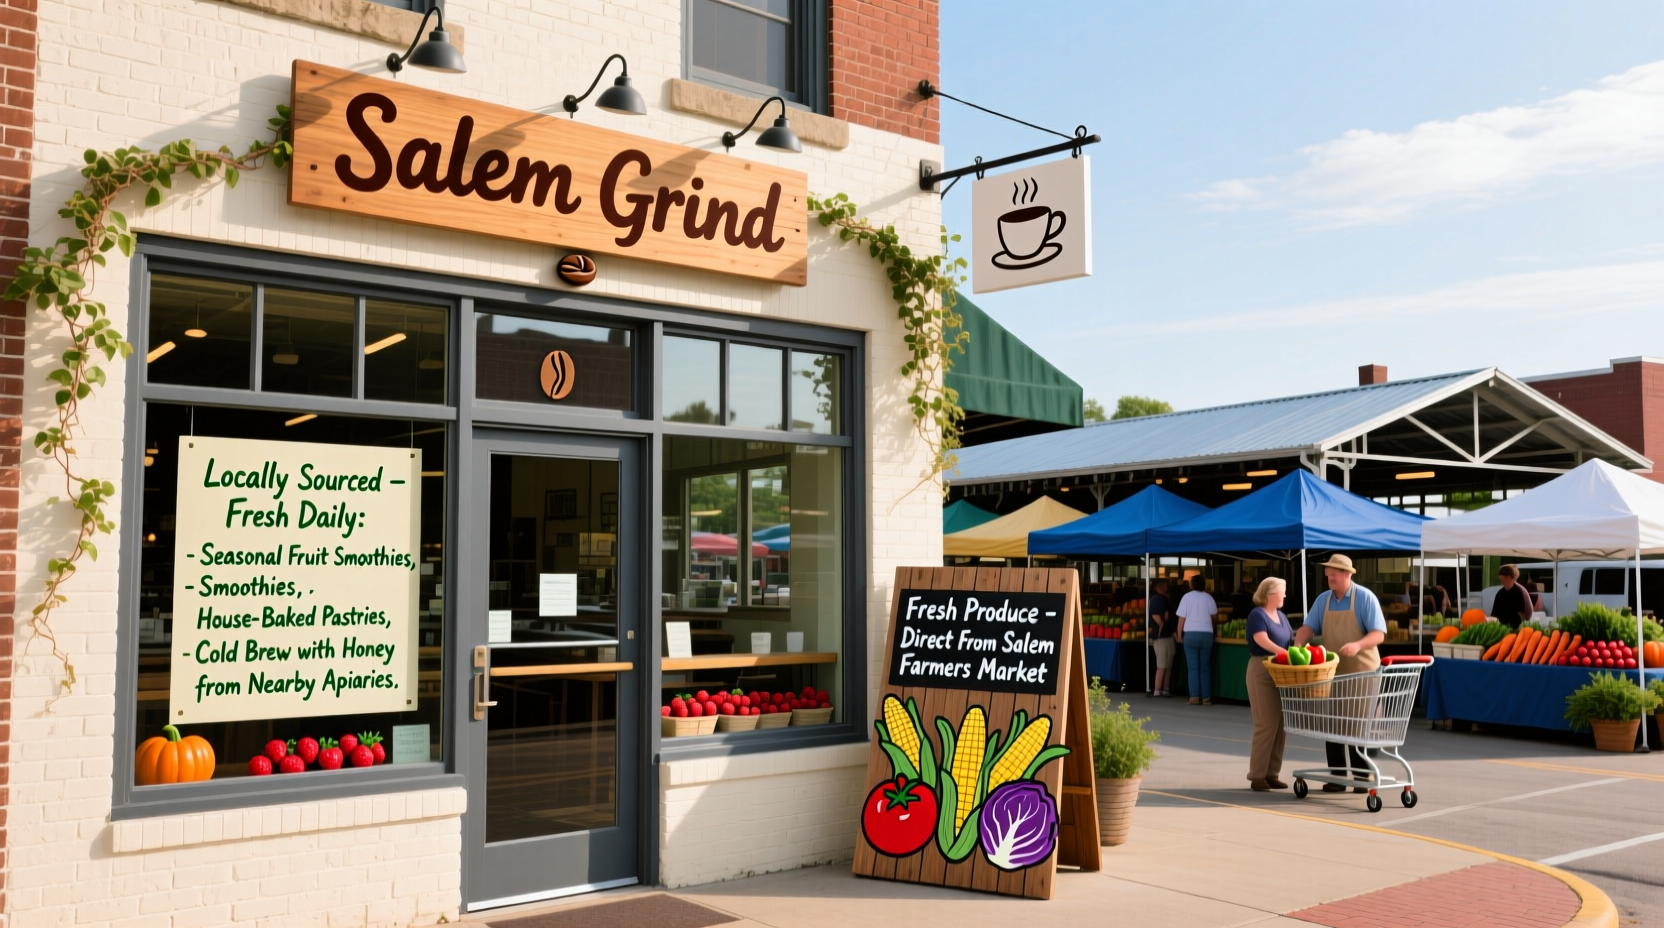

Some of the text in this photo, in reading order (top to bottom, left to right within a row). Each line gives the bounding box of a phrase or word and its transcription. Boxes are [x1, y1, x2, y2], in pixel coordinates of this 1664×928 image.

[334, 92, 785, 253] Salem Grind
[203, 457, 289, 500] Locally
[297, 462, 384, 493] Sourced
[225, 497, 366, 539] Fresh Daily:
[199, 541, 283, 567] Seasonal
[288, 544, 330, 566] Fruit
[198, 574, 303, 600] Smoothies,
[196, 604, 392, 630] House-Baked Pastries,
[905, 595, 958, 621] Fresh
[963, 597, 1040, 625] Produce
[195, 639, 239, 665] Cold
[244, 638, 292, 663] Brew
[297, 637, 336, 660] with
[342, 636, 396, 666] Honey
[899, 625, 1055, 655] Direct From Salem
[899, 652, 1048, 684] Farmers Market
[194, 668, 399, 704] from Nearby Apiaries.
